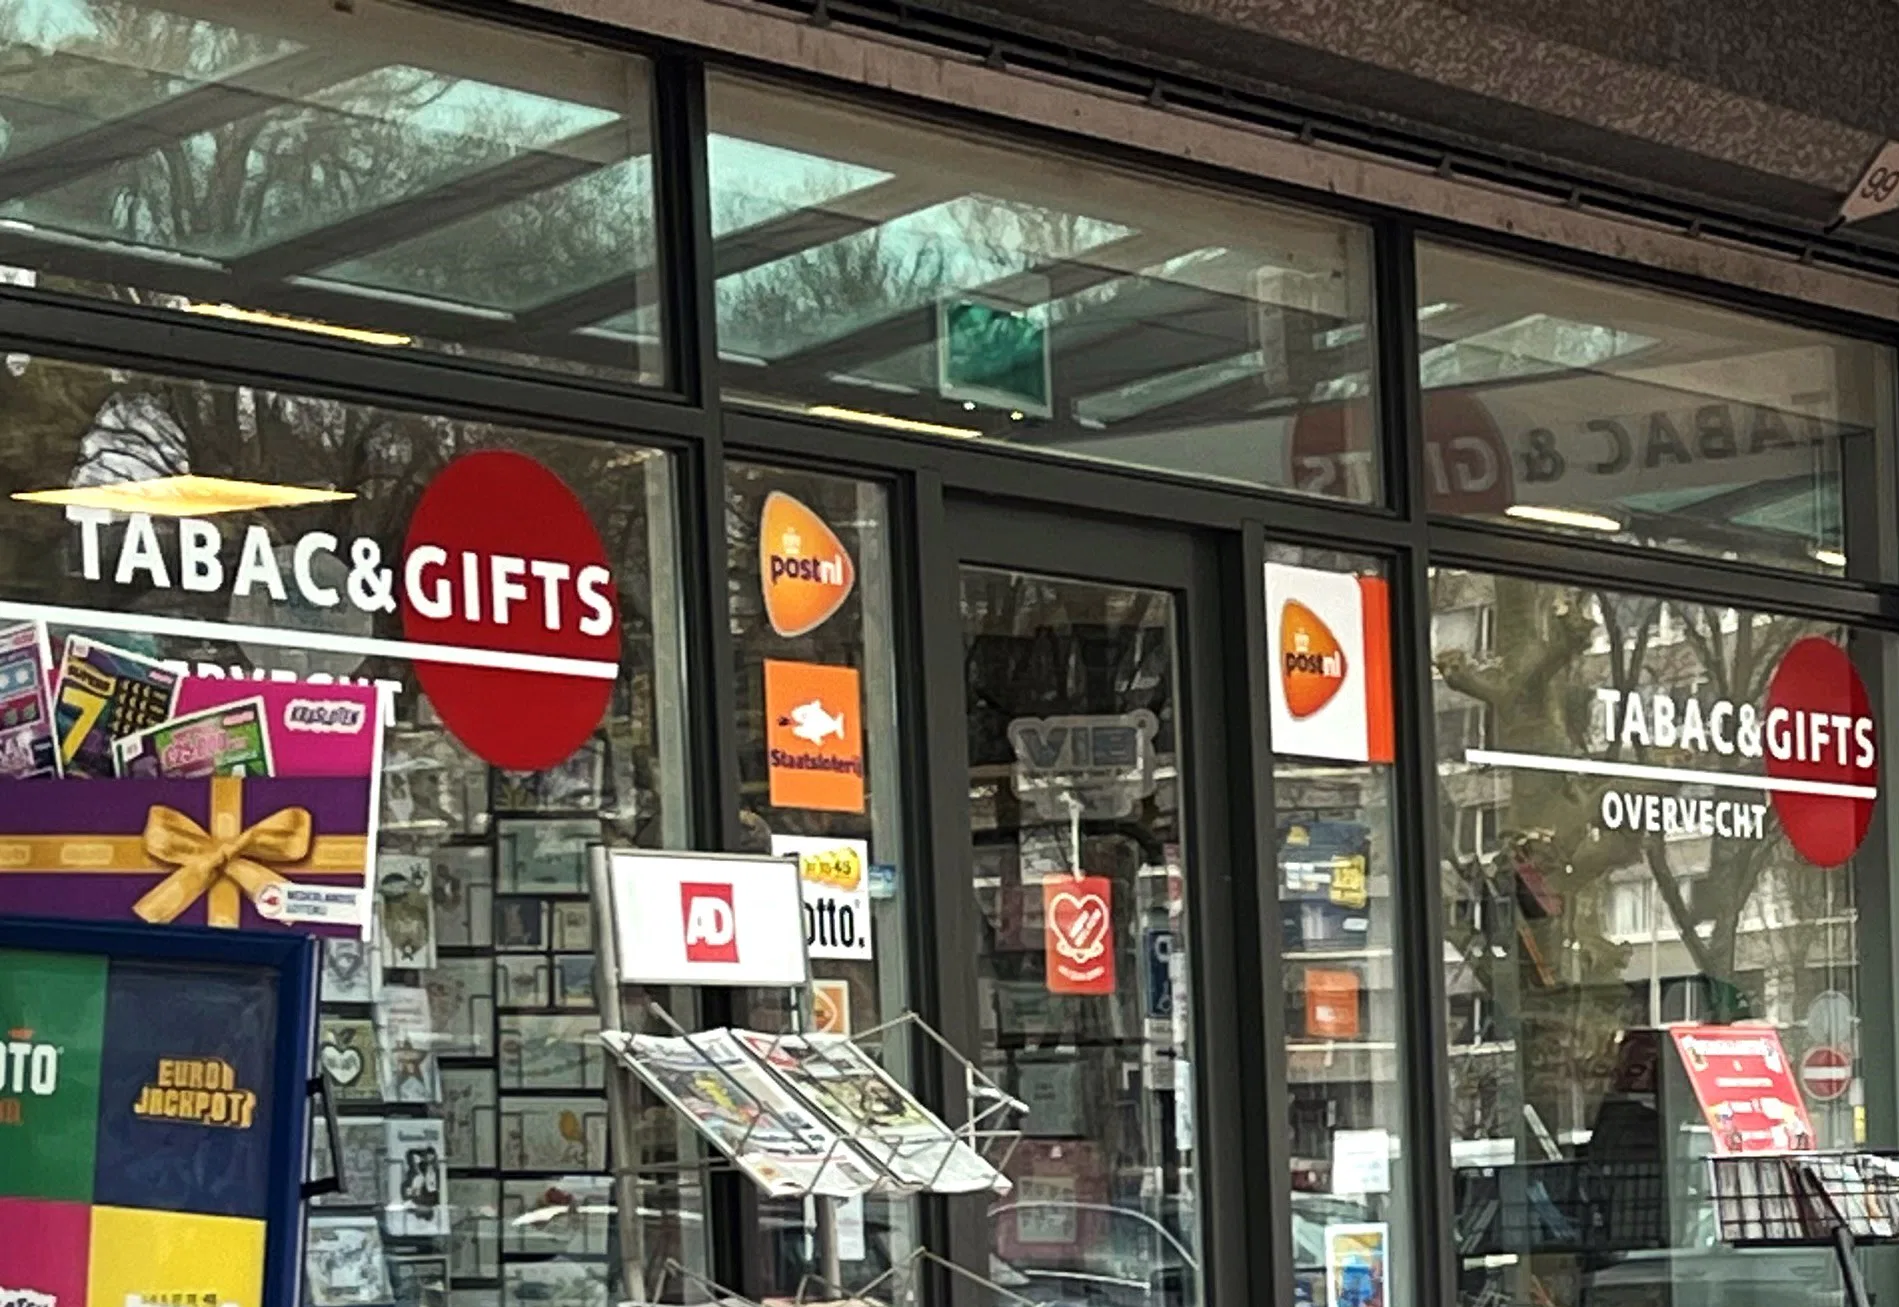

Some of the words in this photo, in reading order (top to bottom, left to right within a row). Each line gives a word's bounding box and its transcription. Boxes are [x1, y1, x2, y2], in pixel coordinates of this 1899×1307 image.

[769, 552, 843, 588] postnl
[1285, 648, 1341, 681] postnl
[770, 749, 863, 779] Staatsloterij
[1602, 791, 1768, 841] OVERVECHT
[686, 895, 734, 946] AD
[804, 897, 865, 949] otto.
[157, 1058, 232, 1090] EURO
[133, 1085, 250, 1126] JACKPOT
